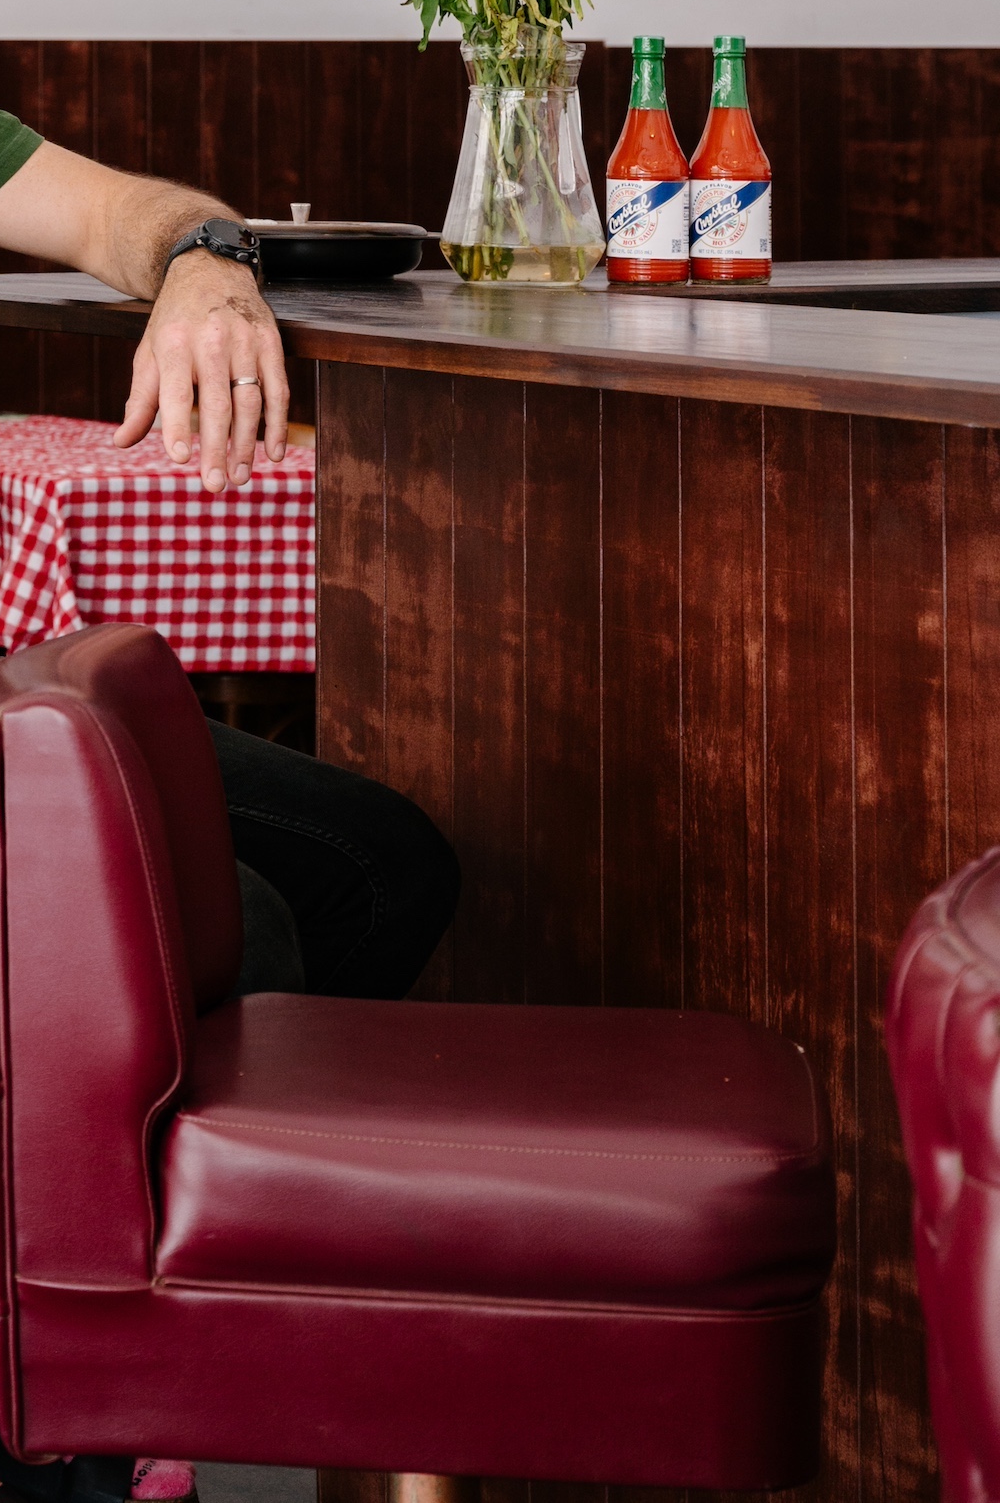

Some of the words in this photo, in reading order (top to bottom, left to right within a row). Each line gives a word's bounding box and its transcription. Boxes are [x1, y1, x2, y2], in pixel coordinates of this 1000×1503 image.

[609, 193, 652, 235] Crystal
[695, 194, 742, 235] Crystal
[638, 222, 656, 242] SAUCE
[729, 221, 745, 243] SAUCE
